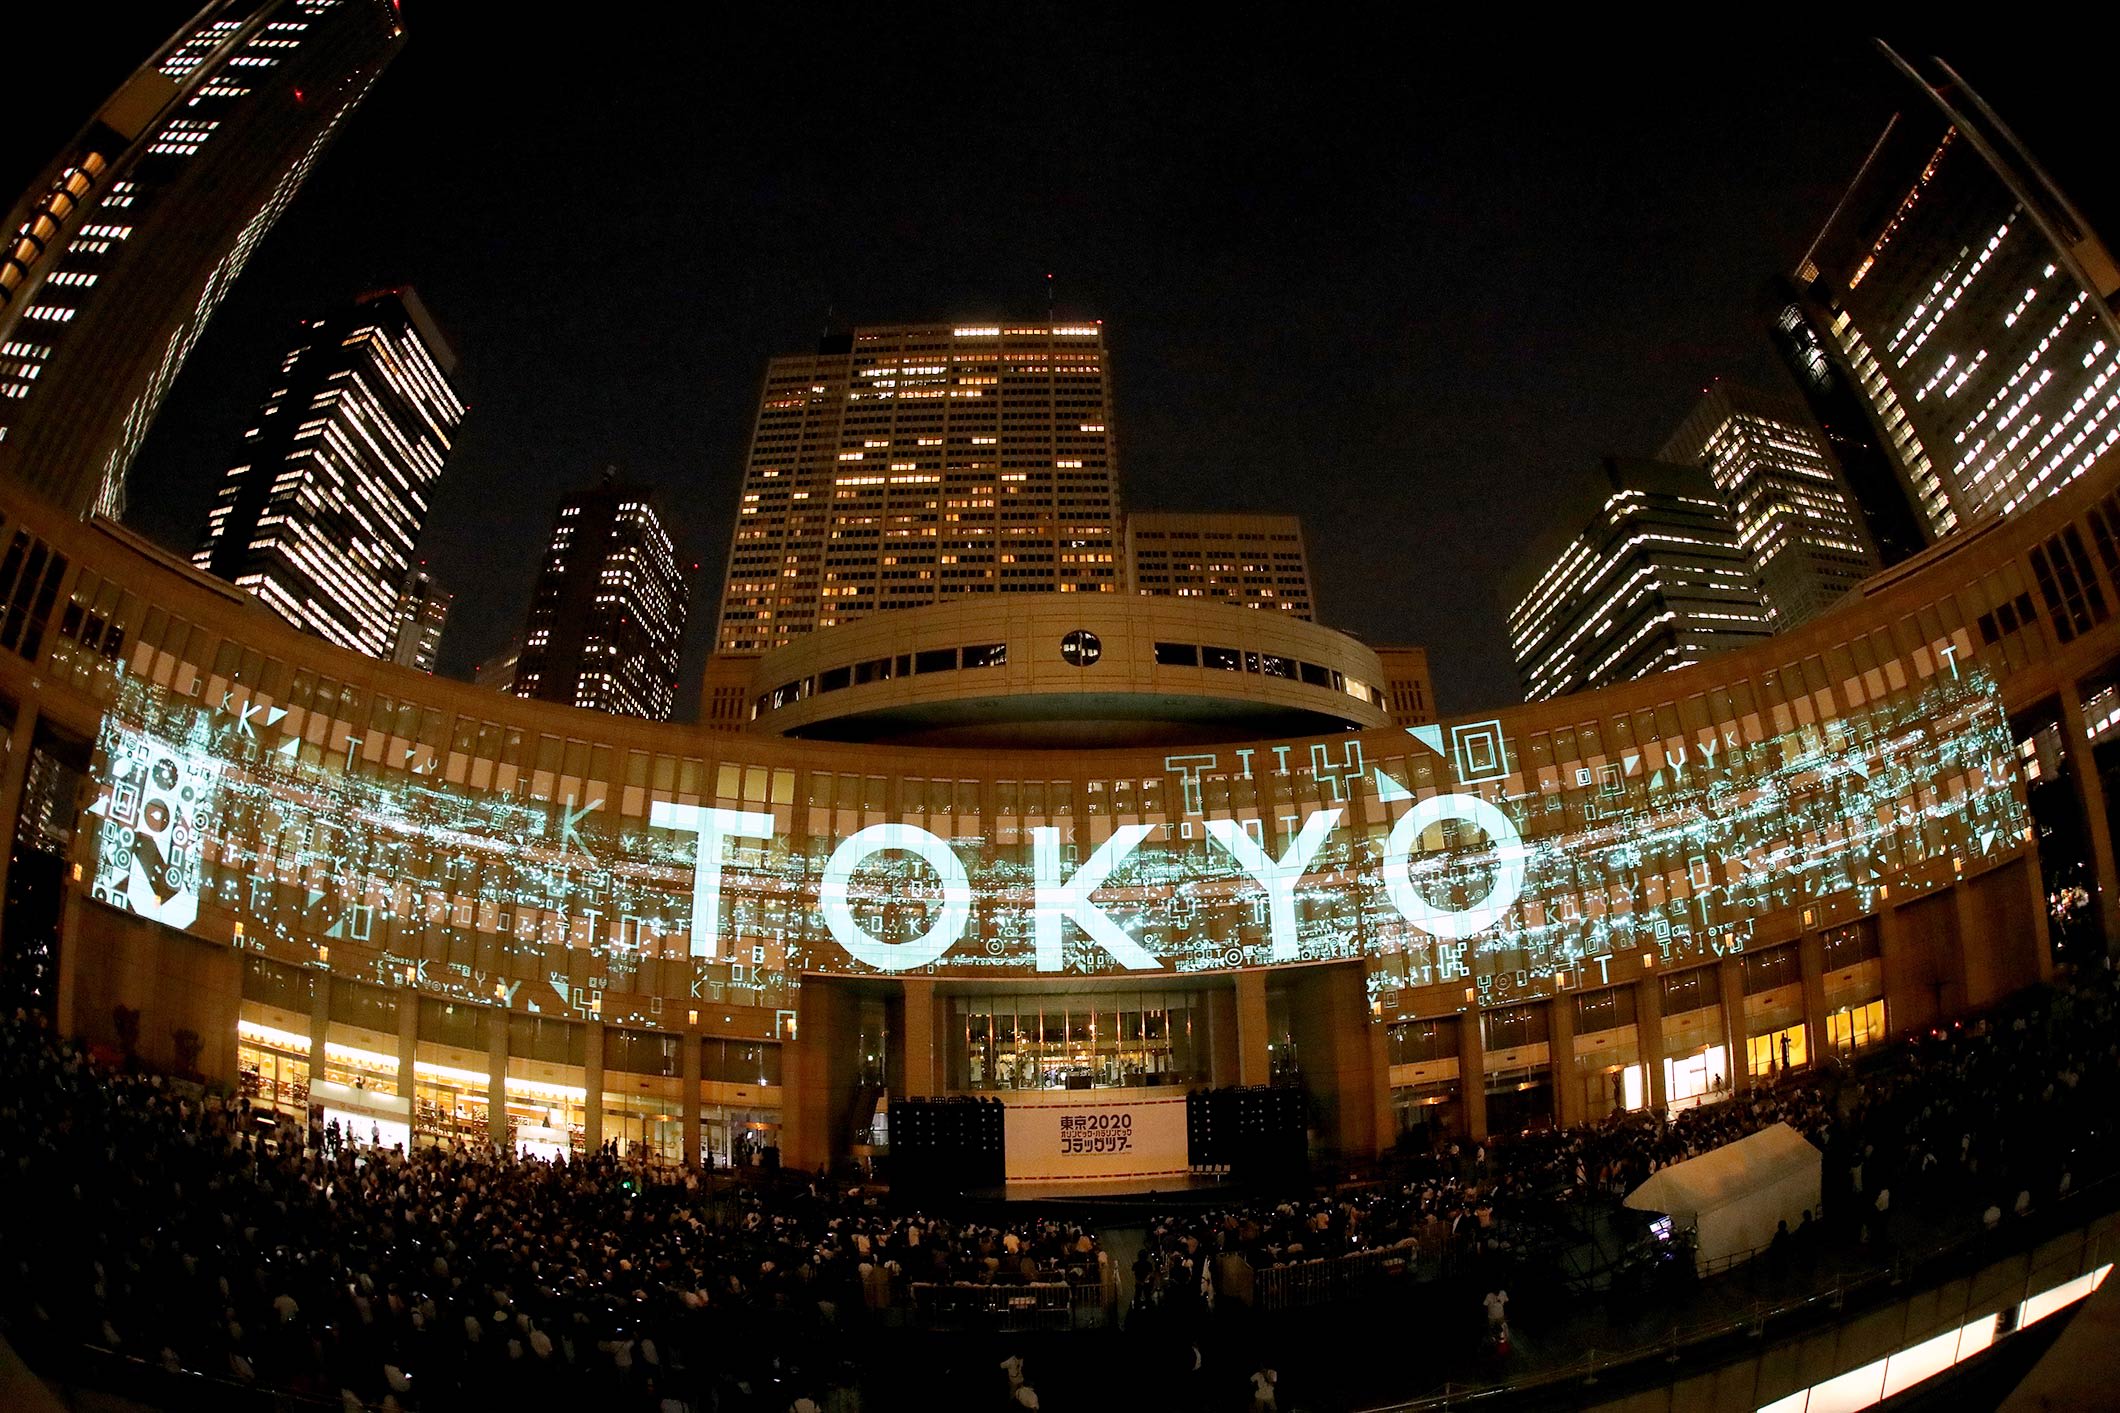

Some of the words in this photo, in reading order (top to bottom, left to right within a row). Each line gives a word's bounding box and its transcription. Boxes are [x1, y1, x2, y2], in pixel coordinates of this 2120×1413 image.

[1941, 645, 1958, 681] T
[237, 700, 262, 738] K
[345, 735, 363, 770] T
[1236, 749, 1255, 778] T
[1272, 746, 1291, 774] T
[1666, 747, 1685, 781] Y
[1697, 739, 1717, 769] Y
[1165, 755, 1217, 816] T
[560, 794, 604, 862] K
[247, 875, 268, 910] T
[649, 793, 1526, 974] TOKYO
[583, 908, 603, 943] T
[1594, 955, 1613, 984] T
[1060, 1113, 1132, 1130] 東京2020
